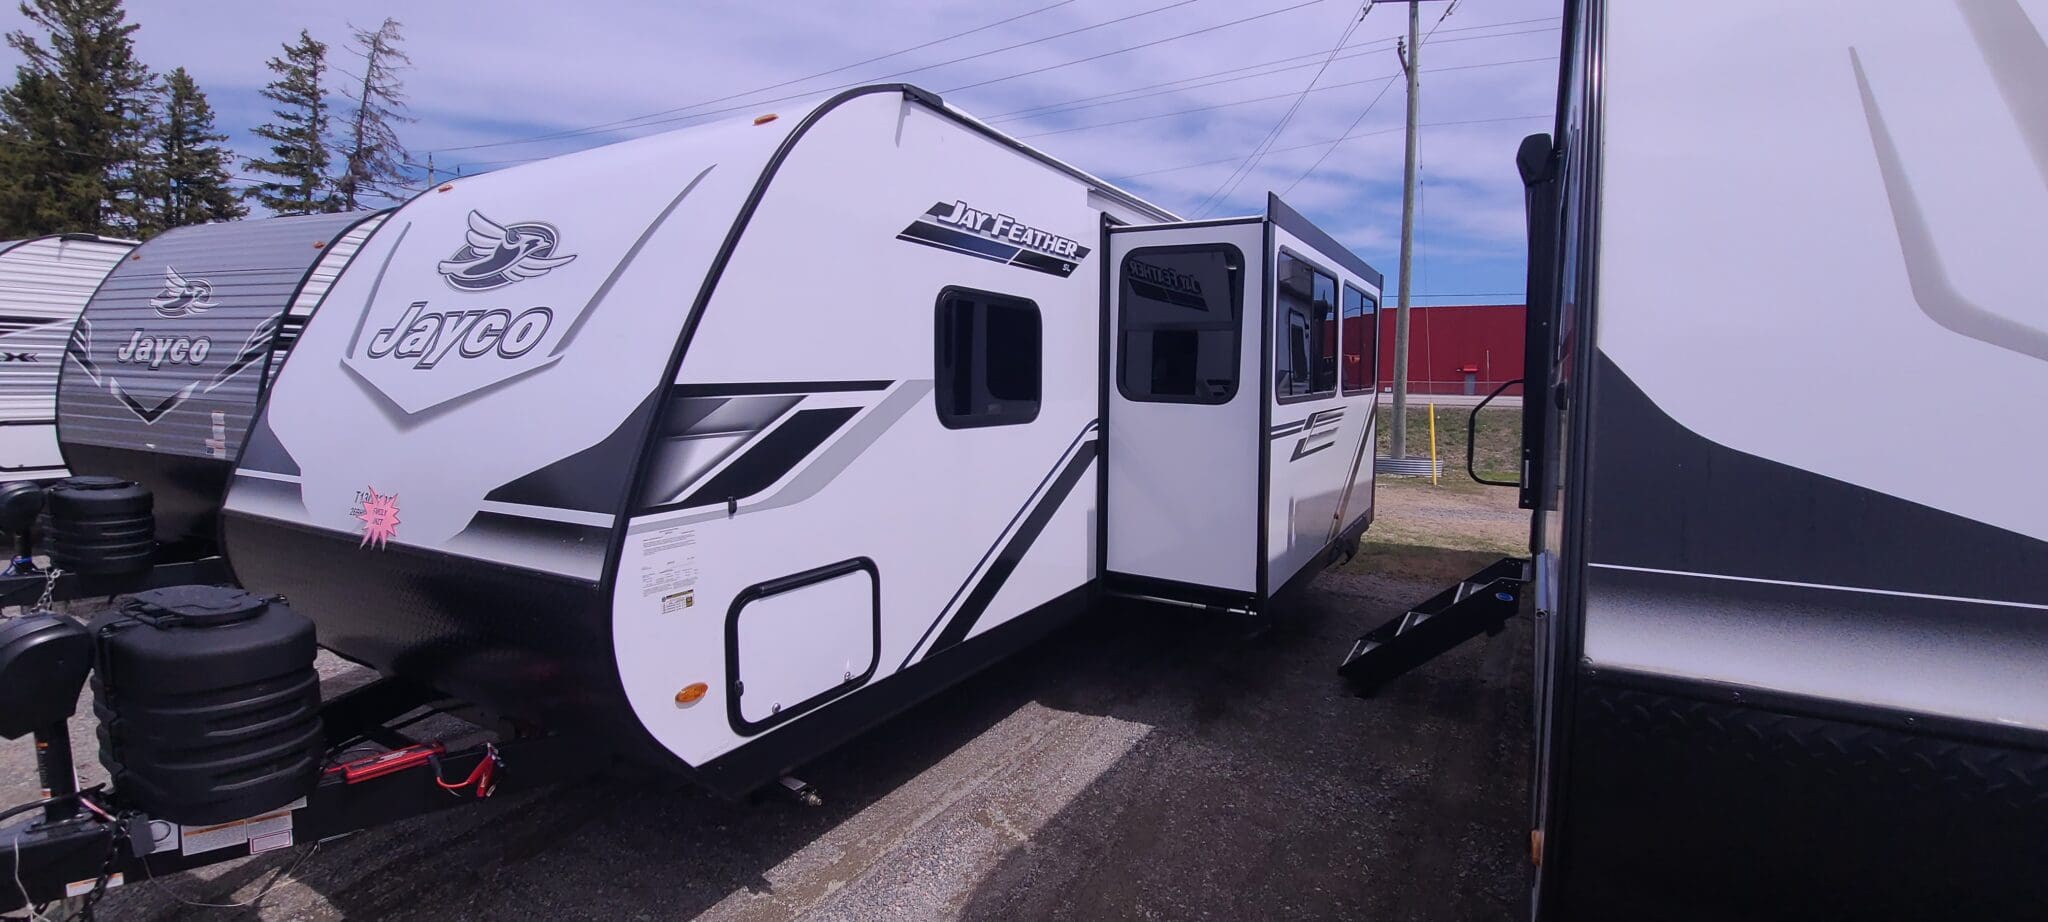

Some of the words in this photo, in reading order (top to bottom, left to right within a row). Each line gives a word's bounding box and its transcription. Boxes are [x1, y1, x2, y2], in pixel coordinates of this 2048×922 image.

[937, 200, 991, 232] JAY
[990, 213, 1079, 258] FEATHER
[1062, 263, 1072, 272] SL
[117, 328, 212, 371] Jayco
[367, 301, 554, 370] Jayco
